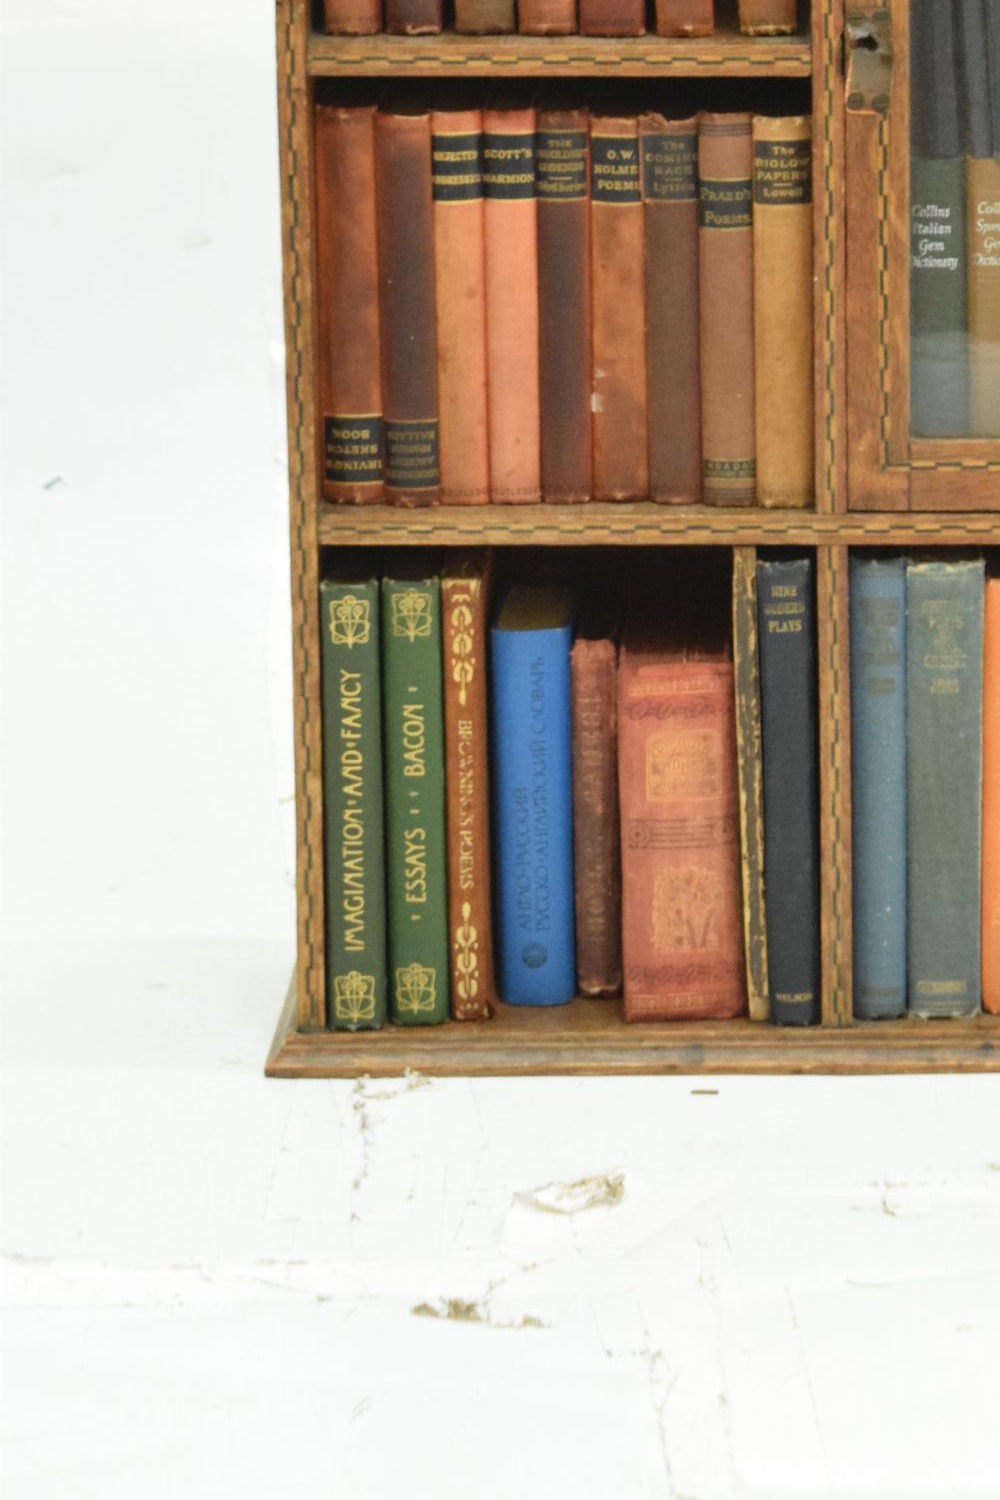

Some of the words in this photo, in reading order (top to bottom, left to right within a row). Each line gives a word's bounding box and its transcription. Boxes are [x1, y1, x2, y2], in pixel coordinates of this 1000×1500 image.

[484, 148, 533, 161] SCOTT'S
[771, 145, 795, 155] The
[655, 166, 693, 175] RACE
[912, 204, 951, 218] Collins
[913, 222, 952, 235] Italian
[918, 239, 945, 255] Gem
[332, 428, 371, 440] BOOK
[327, 444, 378, 455] SKETCH
[768, 619, 802, 633] PLAYS
[529, 655, 547, 734] СЛОВАРЬ
[340, 669, 362, 738] FANCY
[403, 704, 426, 776] BACON
[405, 828, 427, 903] ESSAYS
[460, 830, 474, 890] POEMS
